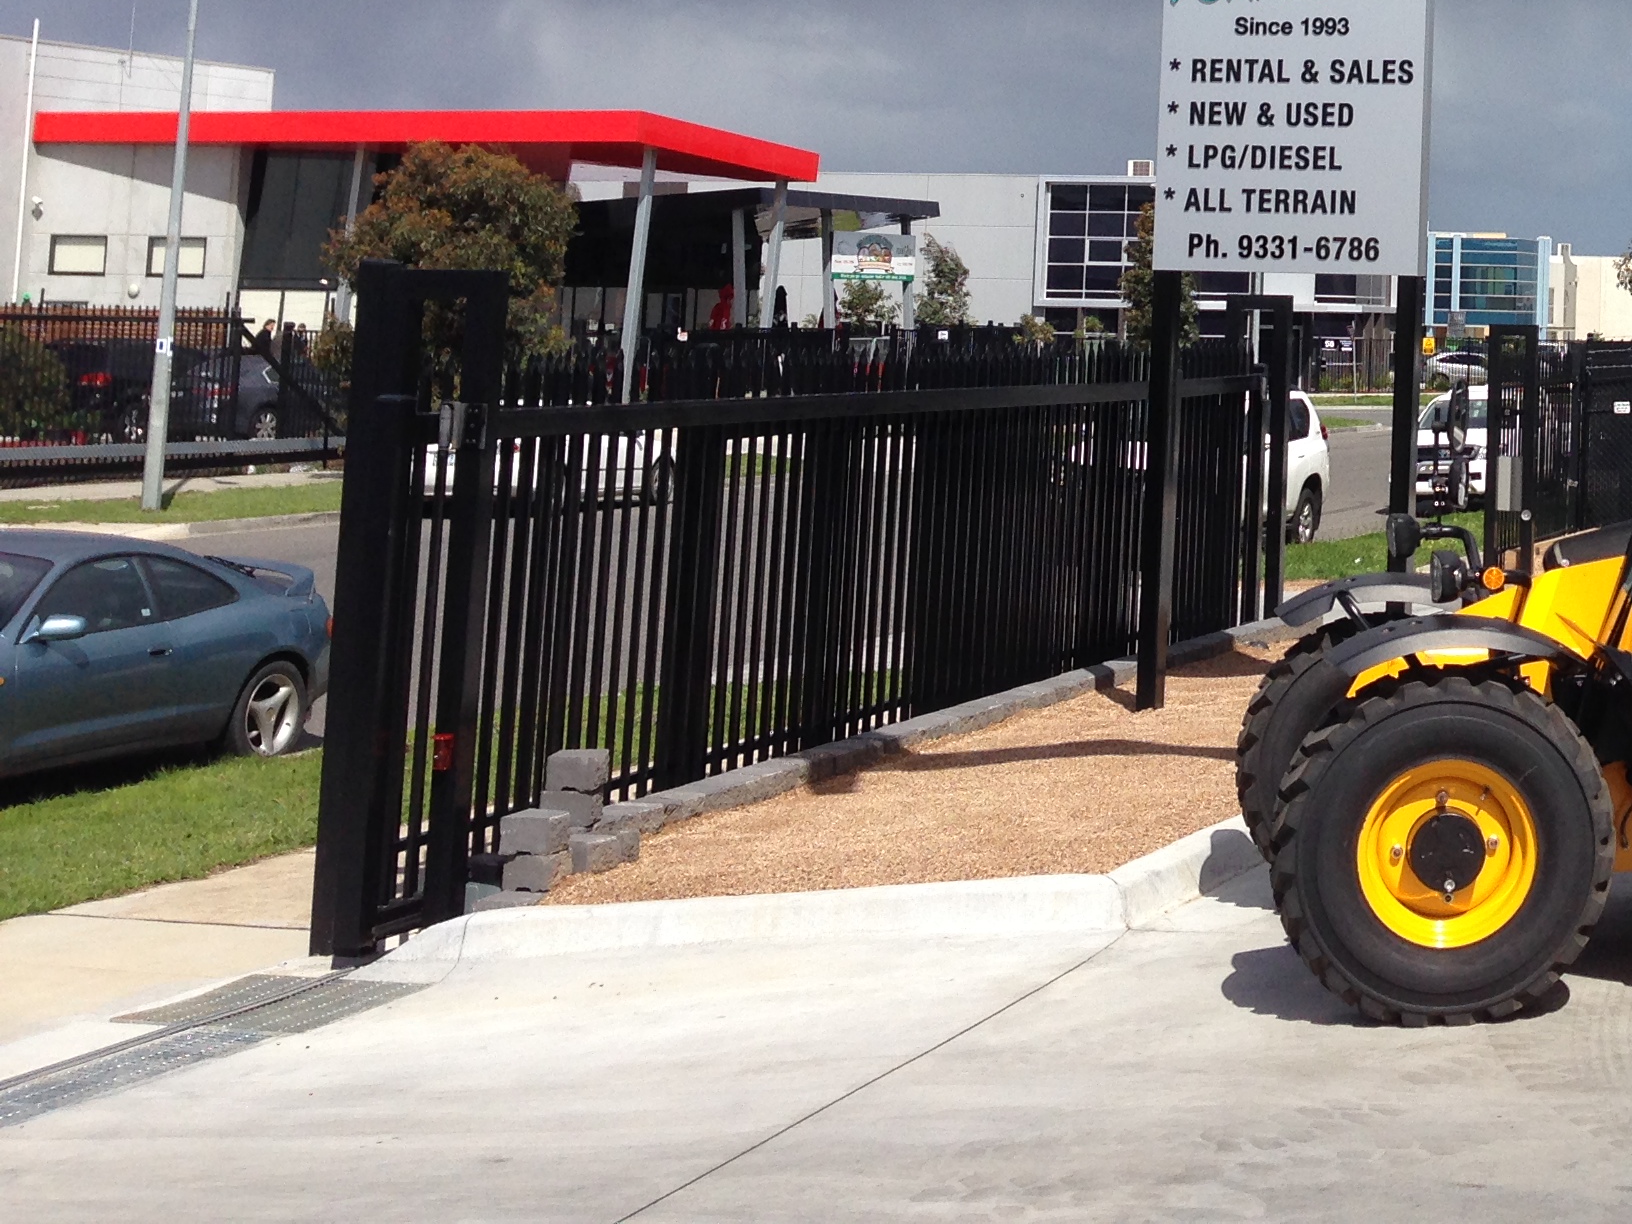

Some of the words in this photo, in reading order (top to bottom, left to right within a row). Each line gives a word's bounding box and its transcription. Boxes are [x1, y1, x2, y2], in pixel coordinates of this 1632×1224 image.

[1234, 17, 1293, 36] Since
[1300, 17, 1350, 36] 1993
[1190, 58, 1290, 83] RENTAL
[1301, 59, 1319, 83] &
[1330, 59, 1414, 84] SALES
[1189, 101, 1247, 126] NEW
[1257, 102, 1275, 126] &
[1286, 102, 1354, 127] USED
[1187, 144, 1342, 170] LPG/DIESEL
[1184, 188, 1232, 213] ALL
[1242, 189, 1356, 215] TERRAIN
[1188, 233, 1228, 259] Ph.
[1238, 234, 1380, 262] 9331-6786
